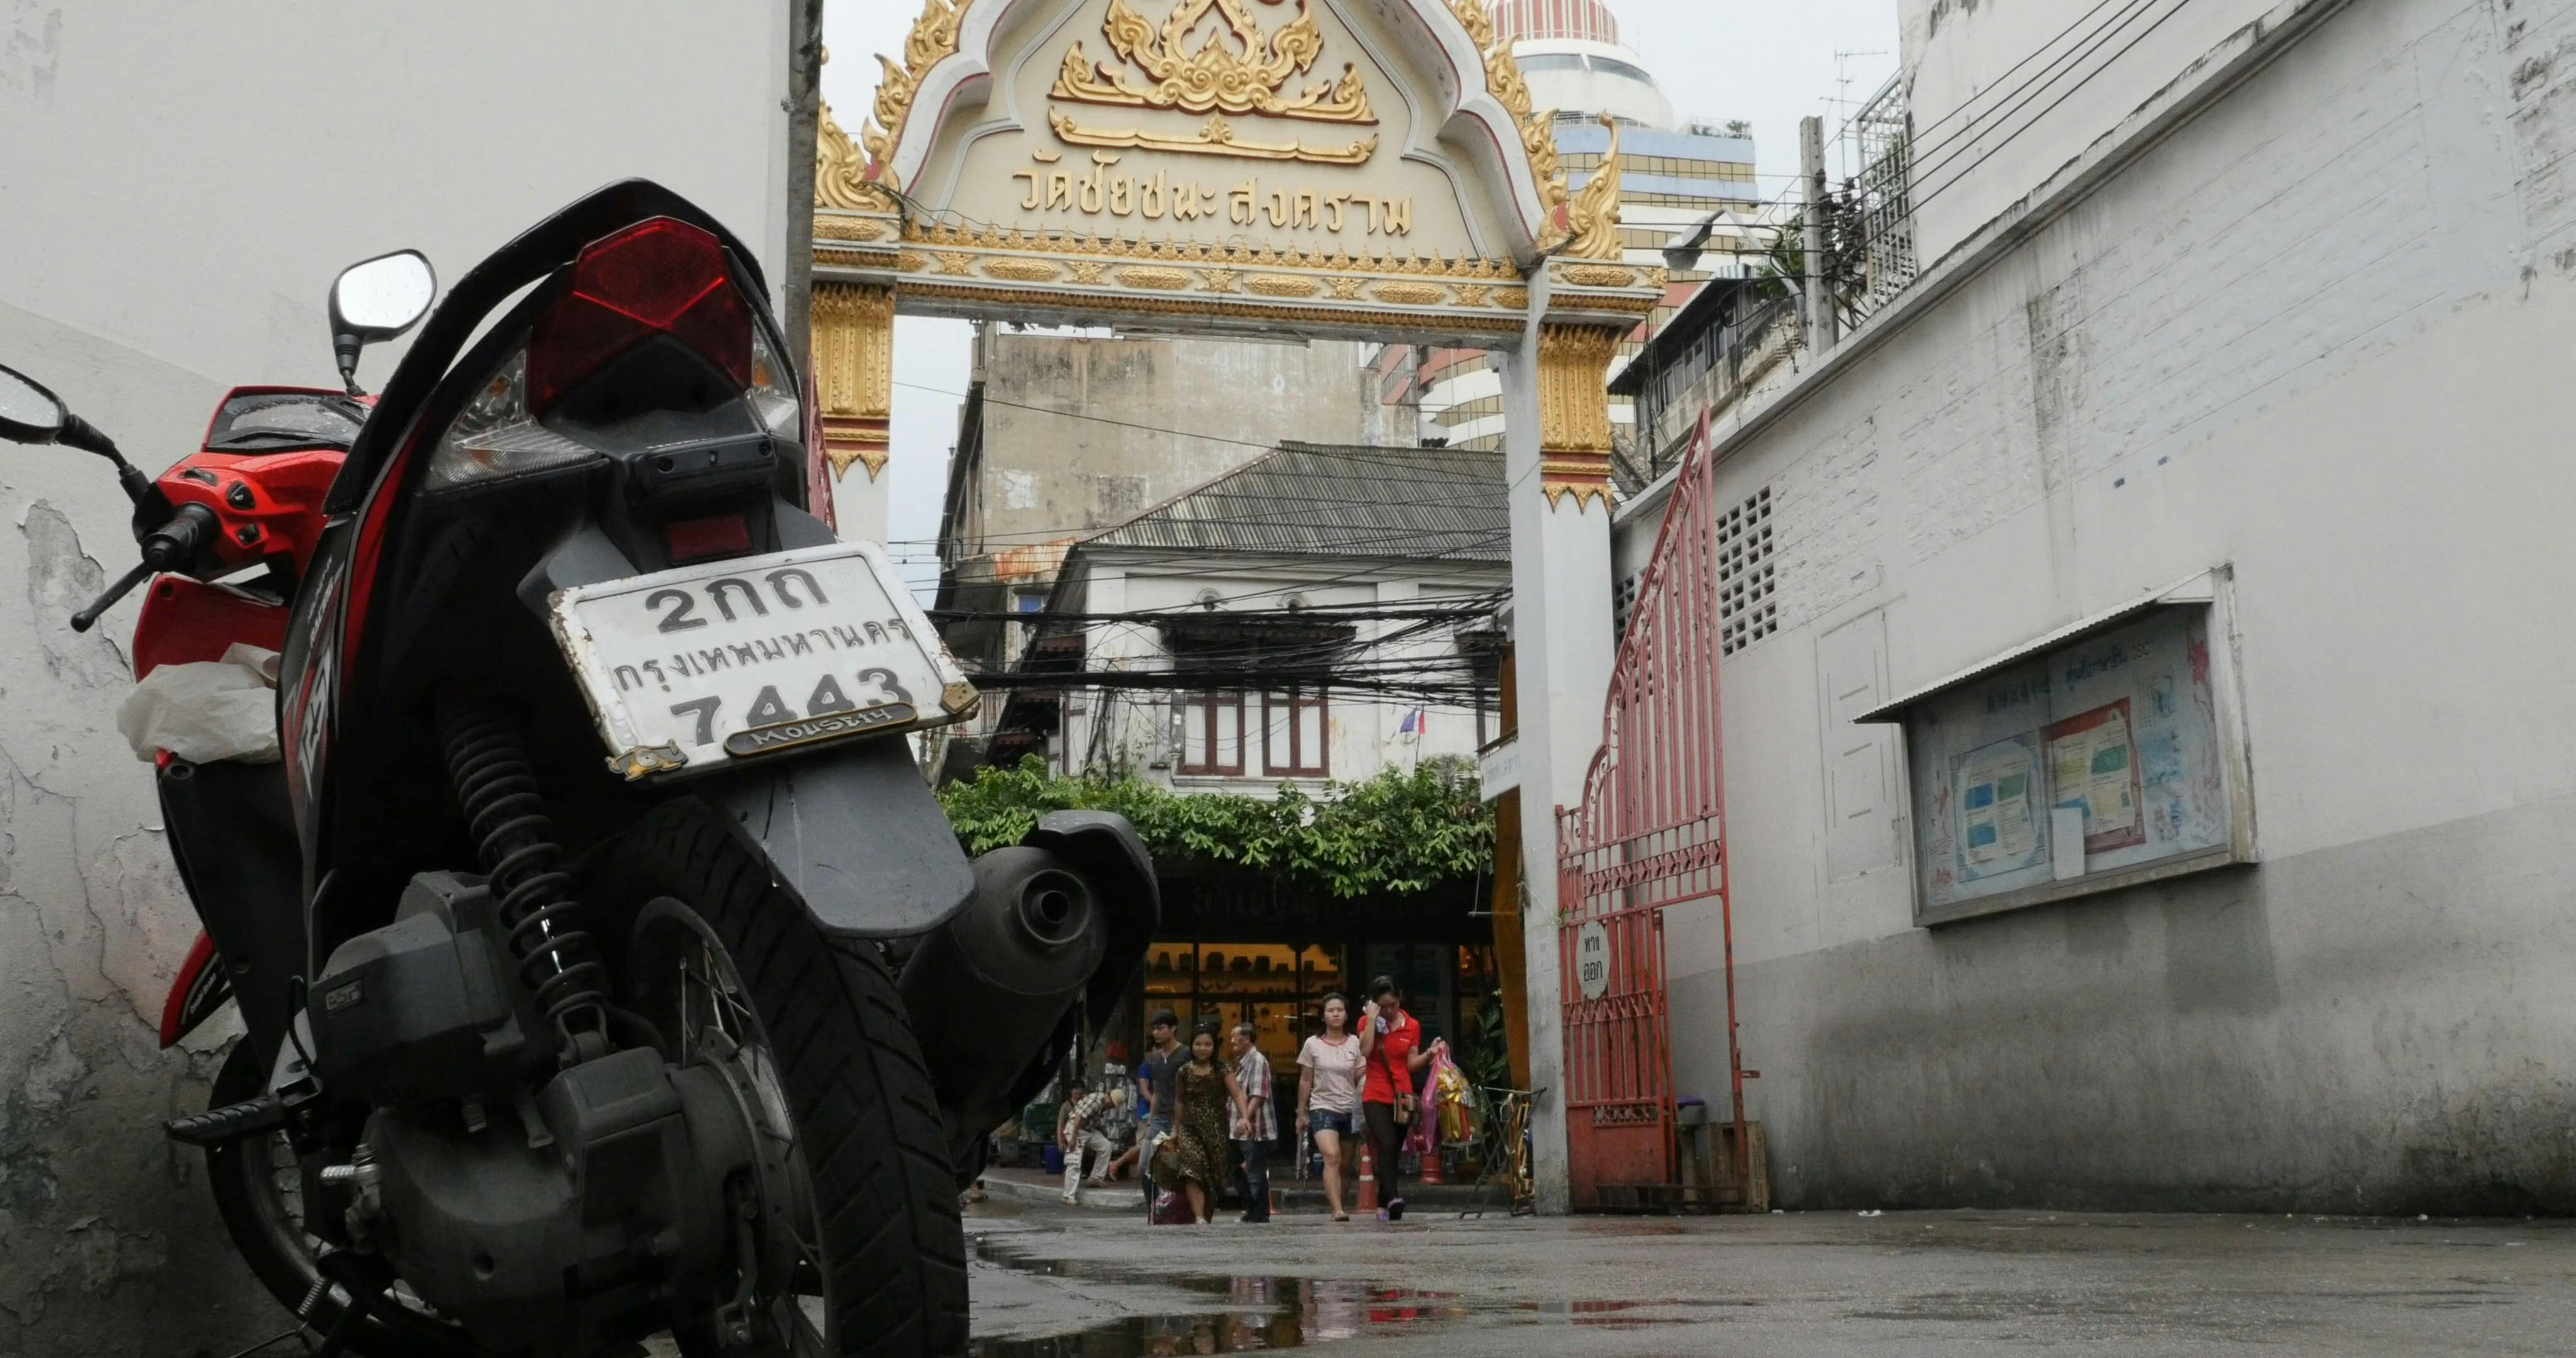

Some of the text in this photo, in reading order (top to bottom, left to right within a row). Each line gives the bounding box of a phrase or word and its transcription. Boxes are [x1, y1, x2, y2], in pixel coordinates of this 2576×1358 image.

[645, 567, 830, 635] 2กถ
[613, 618, 911, 692] กรุงเทพมหานคร
[669, 666, 914, 746] 7443
[1584, 961, 1603, 981] ออก
